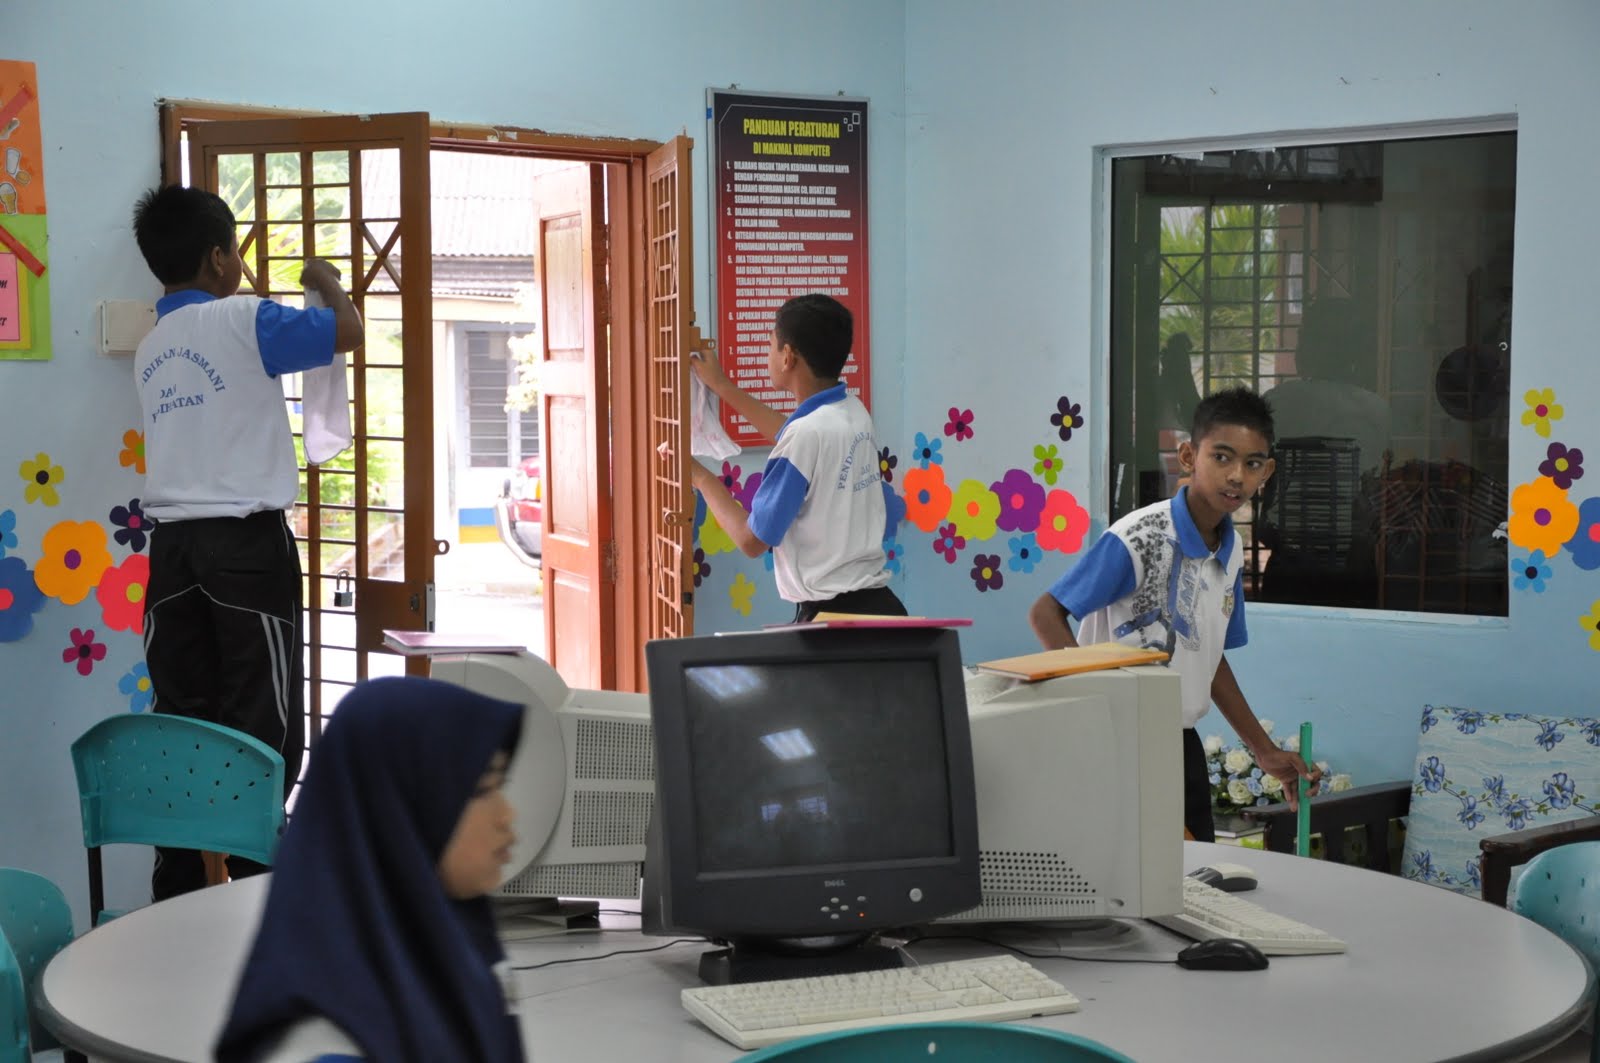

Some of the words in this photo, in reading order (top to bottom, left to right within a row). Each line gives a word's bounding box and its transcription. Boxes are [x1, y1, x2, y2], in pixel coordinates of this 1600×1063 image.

[744, 118, 787, 136] PANDUAN
[788, 121, 840, 138] PERATURAN
[753, 142, 761, 154] DI
[762, 142, 792, 156] MAKMAL
[794, 144, 830, 156] KOMPUTER
[726, 161, 730, 170] 1.
[734, 161, 758, 170] DILARANG
[758, 162, 774, 171] MASUK
[734, 172, 753, 181] DENGAN
[754, 173, 785, 182] PENGAWASAN
[726, 184, 732, 192] 2.
[734, 184, 758, 192] DILARANG
[784, 186, 800, 194] MASUK
[734, 195, 759, 204] SEBARANG
[801, 197, 816, 205] DALAM
[735, 207, 758, 216] DILARANG
[728, 231, 732, 240] 4.
[728, 255, 732, 264] 5.
[736, 312, 760, 320] LAPORKAN
[761, 311, 776, 320] DENGA
[736, 322, 764, 332] KEROSAKAN
[736, 334, 750, 342] GURU
[737, 346, 760, 354] PASTIKAN
[738, 369, 757, 378] PELAJAR
[738, 380, 762, 388] KOMPUTER
[762, 390, 786, 398] MEMBAWA
